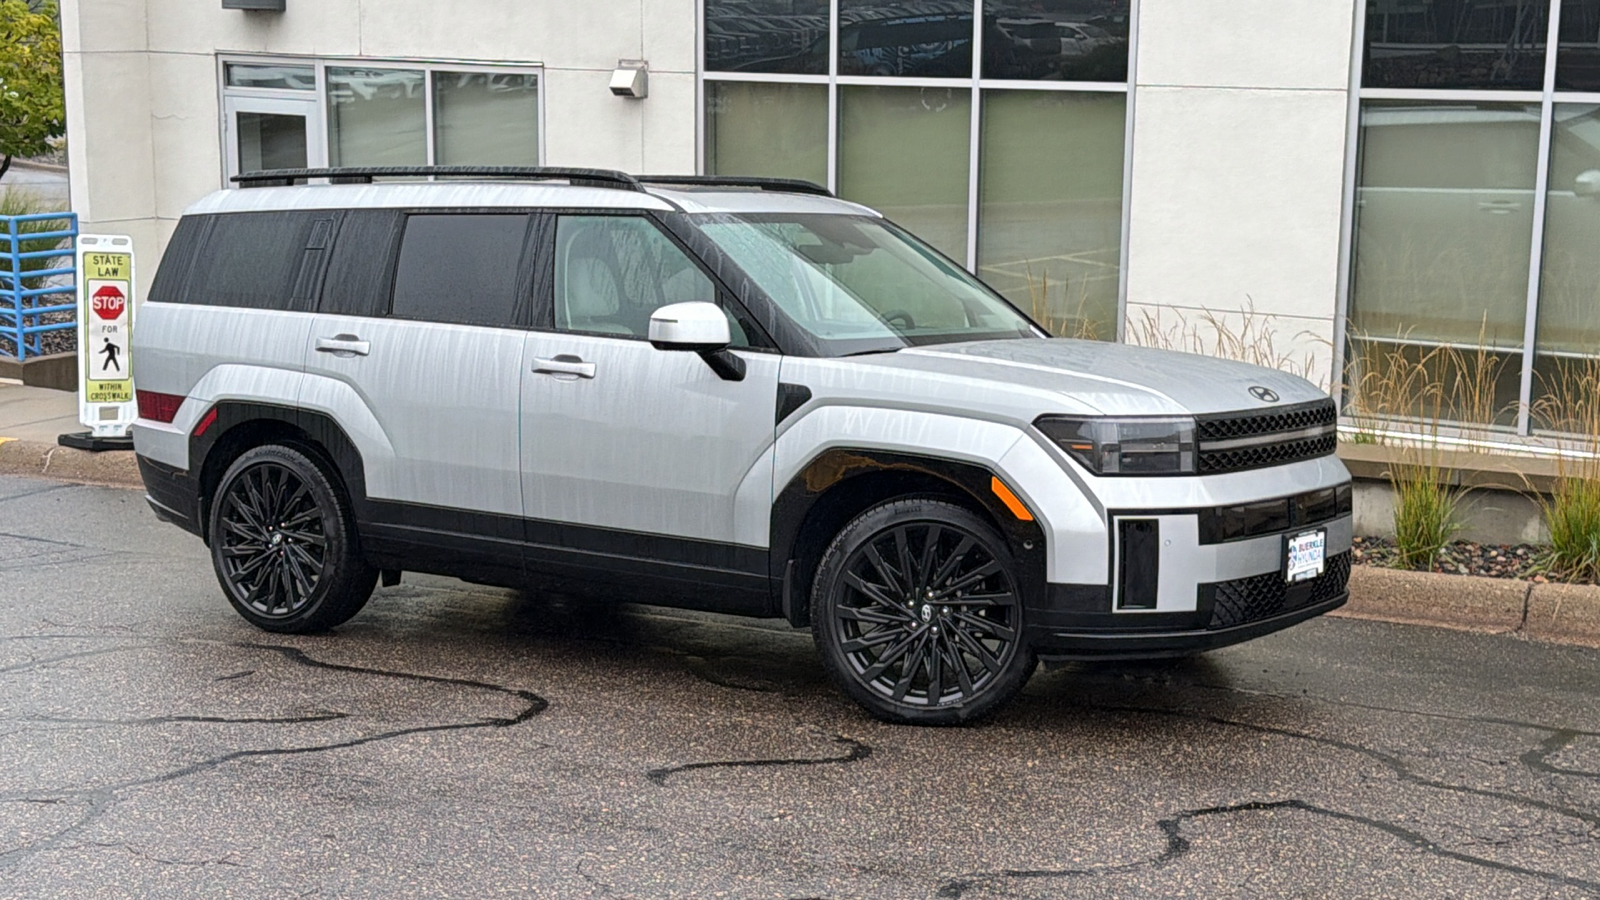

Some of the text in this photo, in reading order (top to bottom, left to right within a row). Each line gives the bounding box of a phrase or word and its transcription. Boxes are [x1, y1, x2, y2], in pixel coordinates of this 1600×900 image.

[93, 255, 123, 265] STATE
[98, 267, 119, 277] LAW
[93, 296, 124, 310] STOP
[102, 325, 118, 333] FOR
[99, 383, 122, 391] WITHIN
[91, 392, 129, 401] CROSSWALK
